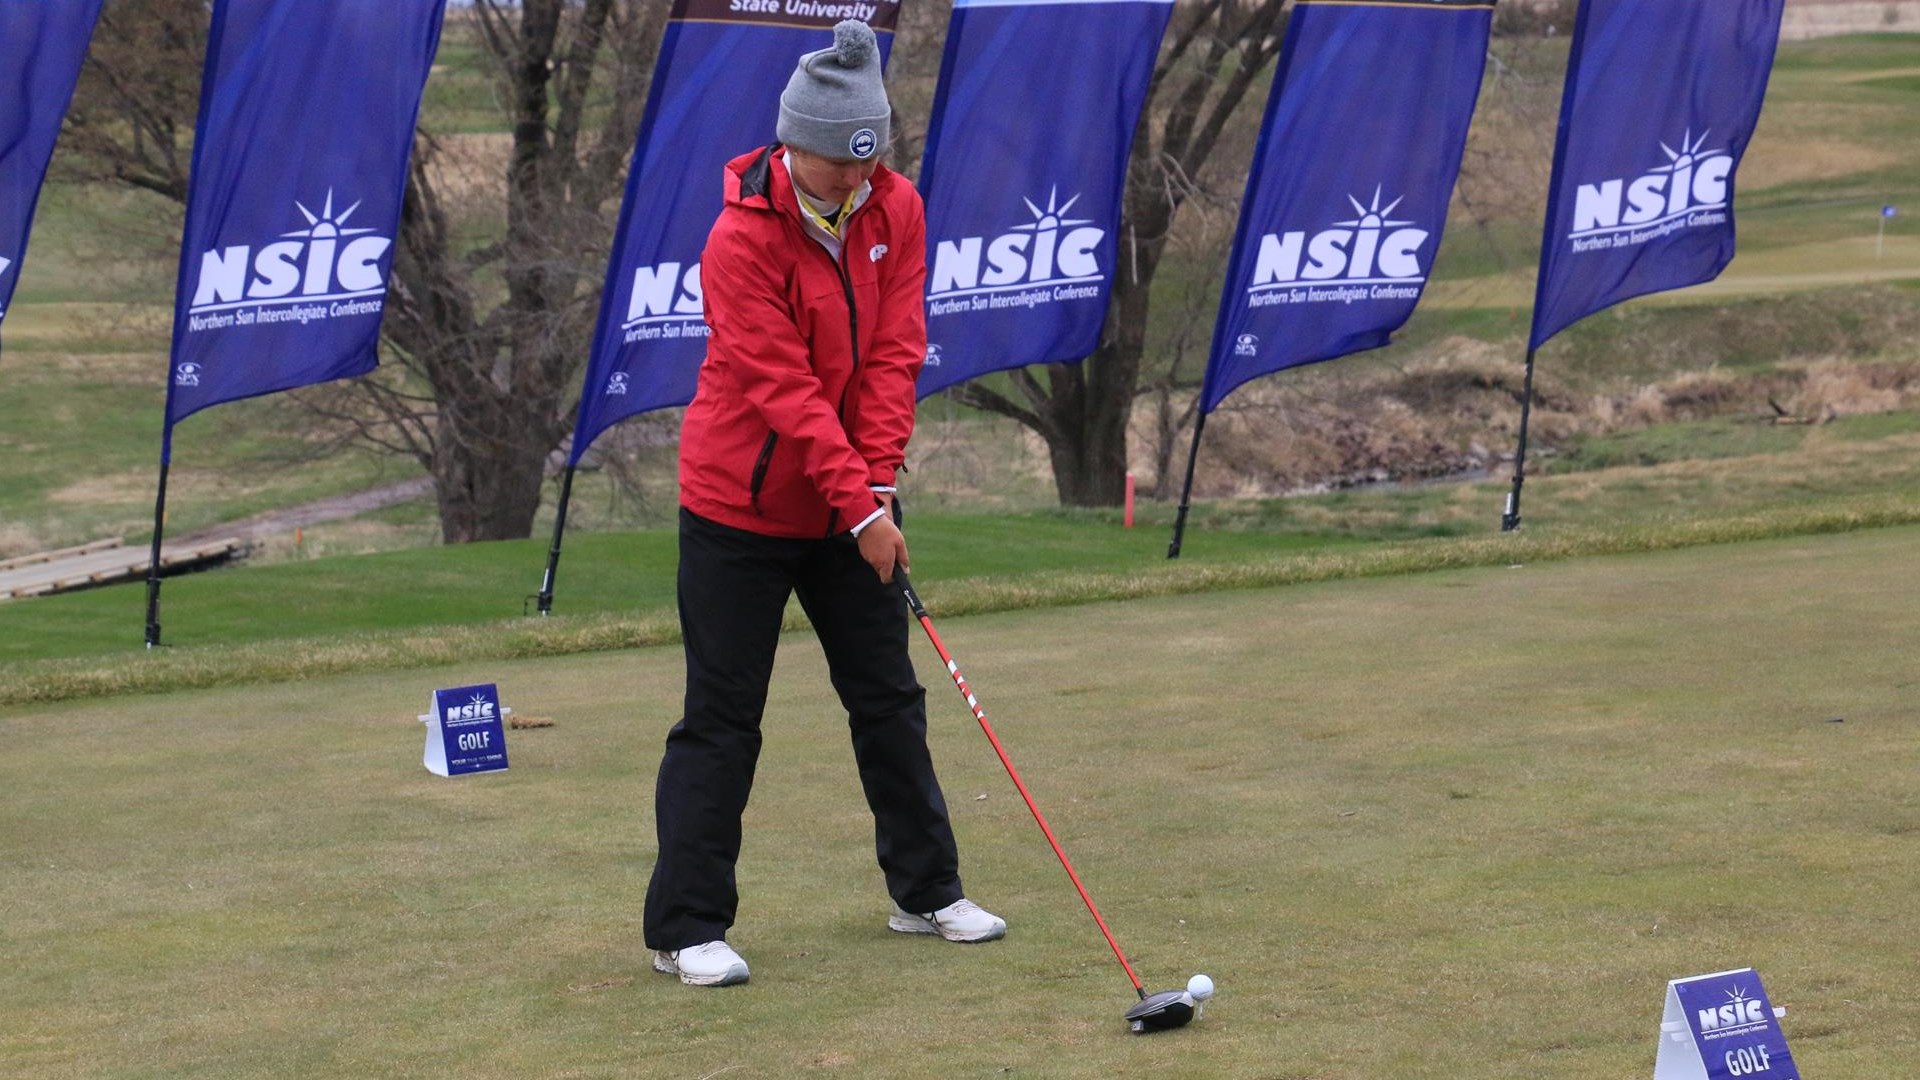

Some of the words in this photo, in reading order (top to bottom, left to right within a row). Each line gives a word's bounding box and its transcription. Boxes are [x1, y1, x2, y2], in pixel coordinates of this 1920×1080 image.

[729, 0, 780, 13] State
[785, 0, 877, 21] University
[1573, 154, 1733, 232] NSIC
[931, 215, 1105, 294] NSIC
[1253, 214, 1429, 286] NSIC
[1573, 235, 1612, 253] Northern
[1613, 232, 1629, 247] Sun
[192, 222, 392, 307] NSIC
[929, 299, 970, 317] Northern
[971, 295, 988, 310] Sun
[989, 288, 1051, 309] Intercollegiate
[1053, 285, 1099, 301] Conference
[1248, 290, 1289, 308] Northern
[1290, 288, 1306, 303] Sun
[1308, 285, 1368, 304] Intercollegiate
[1370, 284, 1419, 299] Conference
[188, 310, 234, 332] Northern
[235, 308, 255, 326] Sun
[256, 303, 328, 325] Intercollegiate
[329, 299, 382, 317] Conference
[623, 324, 660, 344] Northern
[662, 322, 680, 338] Sun
[447, 701, 494, 720] NSIC
[458, 731, 490, 751] GOLF
[1699, 997, 1766, 1031] NSIC
[1725, 1044, 1770, 1076] GOLF
